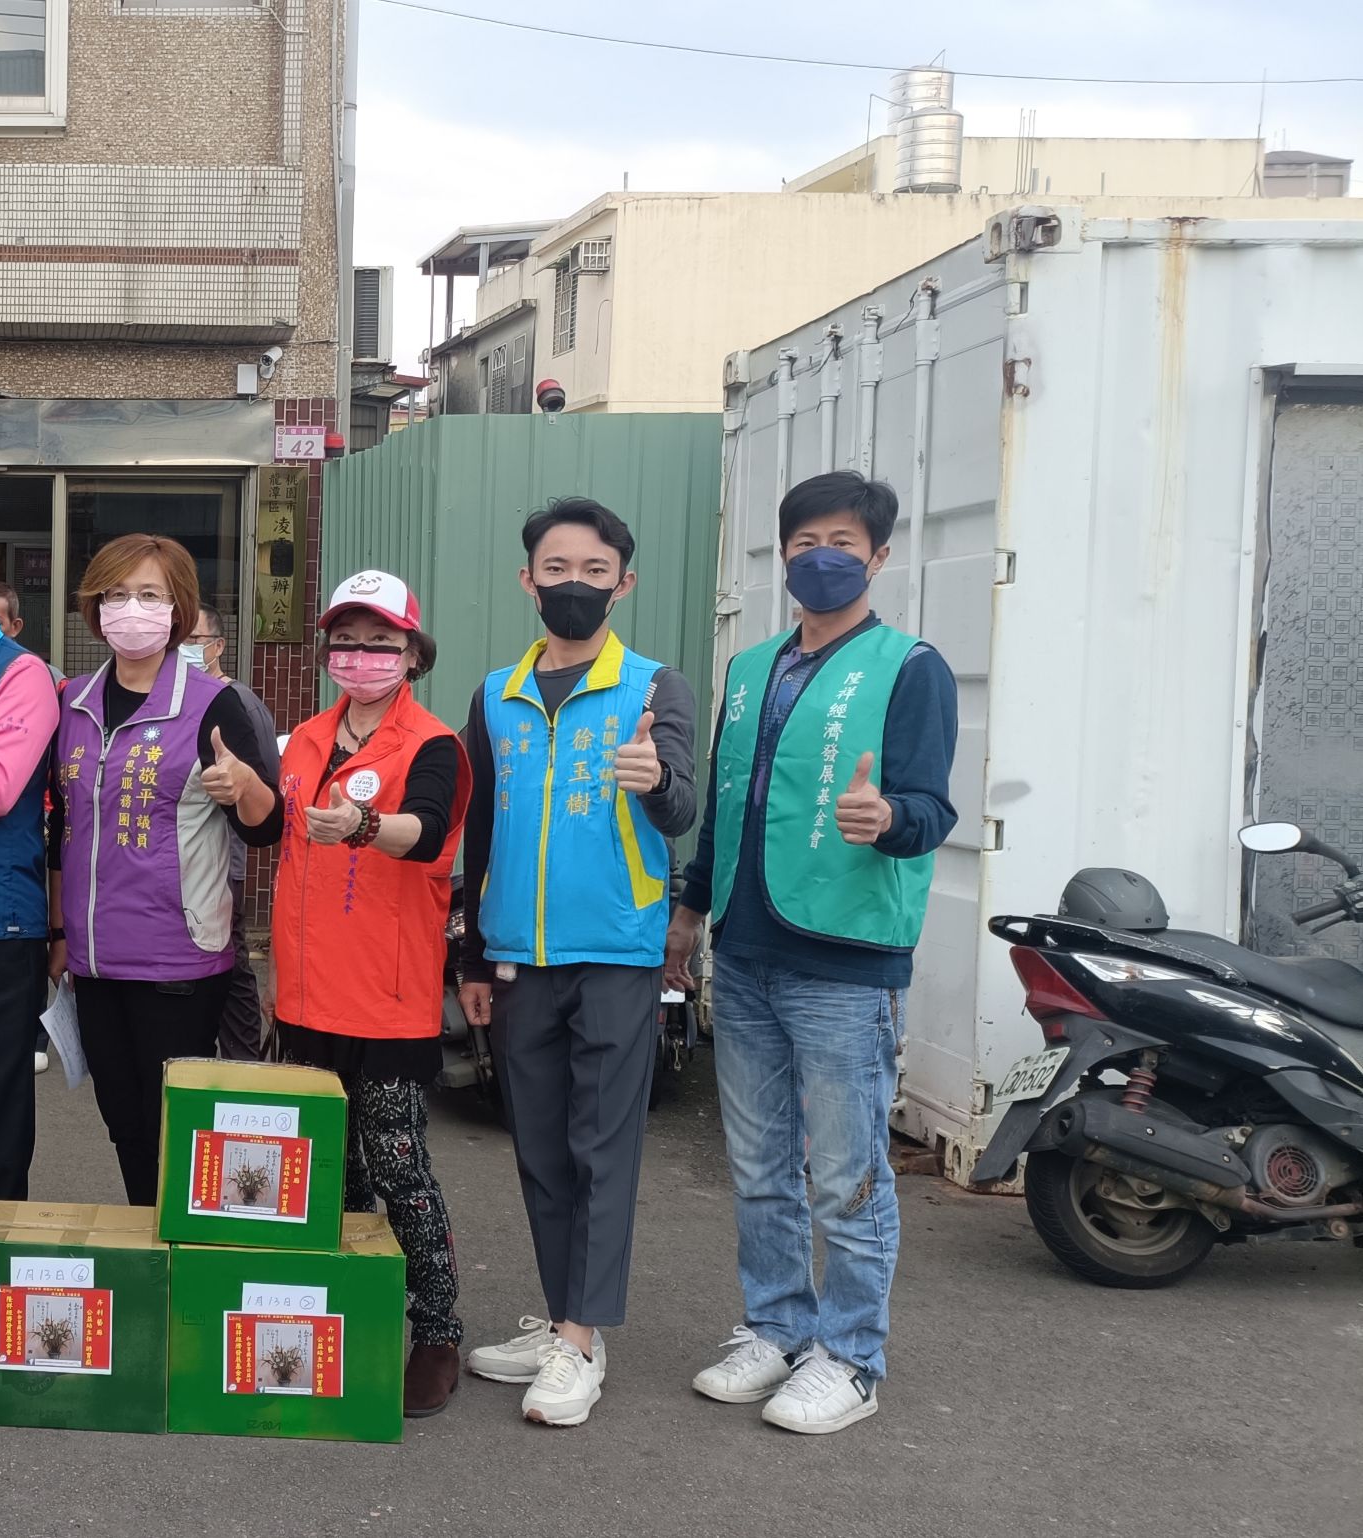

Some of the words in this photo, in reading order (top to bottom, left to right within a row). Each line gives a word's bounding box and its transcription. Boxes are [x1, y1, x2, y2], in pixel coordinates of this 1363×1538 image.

[290, 439, 315, 457] 42
[268, 473, 280, 513] 龍潭區
[286, 474, 299, 513] 桃園市
[270, 516, 291, 637] 凌辦公處
[726, 684, 748, 722] 志
[68, 745, 85, 779] 助理
[565, 727, 595, 816] 徐玉樹
[808, 671, 864, 849] 隆祥經濟發展基金會
[117, 744, 143, 847] 感恩服務團隊
[135, 745, 163, 848] 黃敬平議員
[247, 1296, 291, 1307] 1月13日
